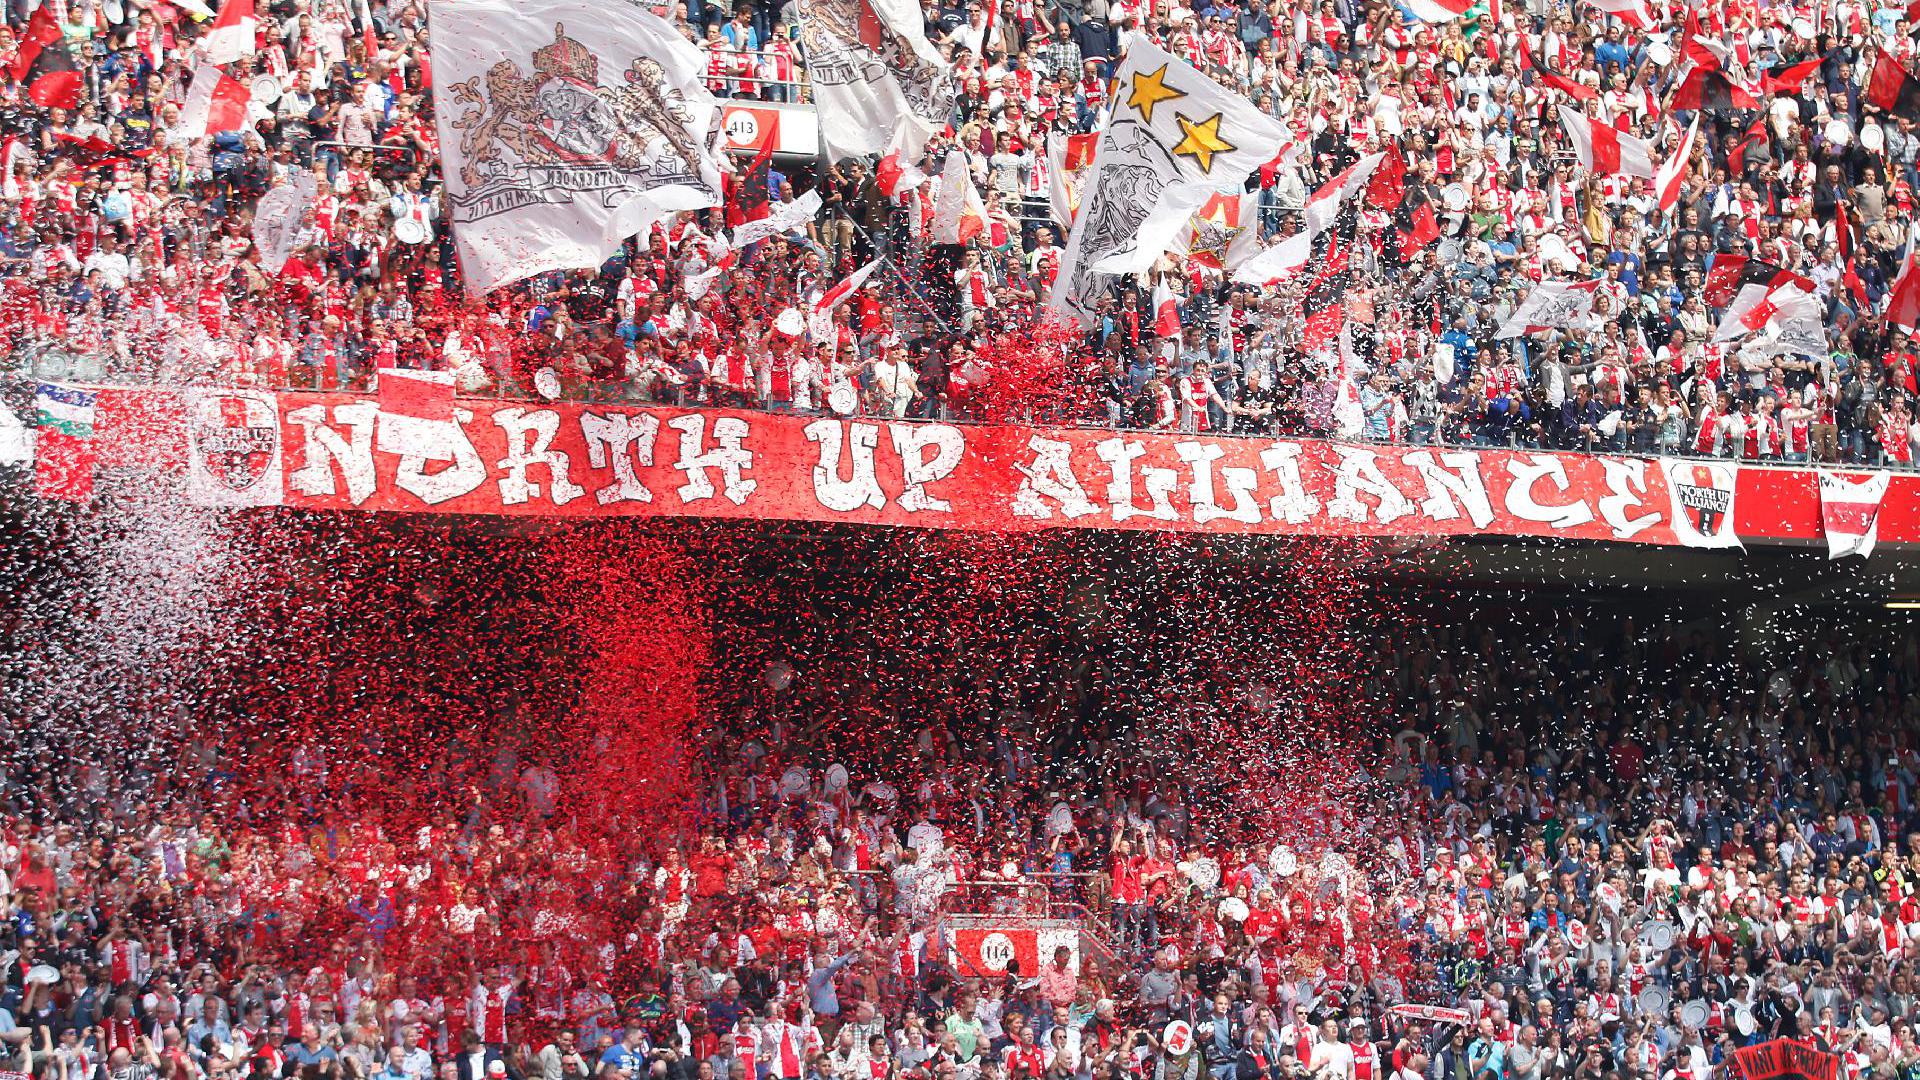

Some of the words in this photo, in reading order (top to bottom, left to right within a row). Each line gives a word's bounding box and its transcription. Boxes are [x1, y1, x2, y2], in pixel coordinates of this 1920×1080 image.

[730, 121, 754, 134] 413
[286, 400, 758, 506] NORTH
[804, 418, 965, 513] UP
[1012, 434, 1663, 540] ALLIANCE
[1678, 484, 1716, 500] NORTH
[1684, 494, 1727, 514] ALLIANCE
[986, 945, 1009, 959] 114
